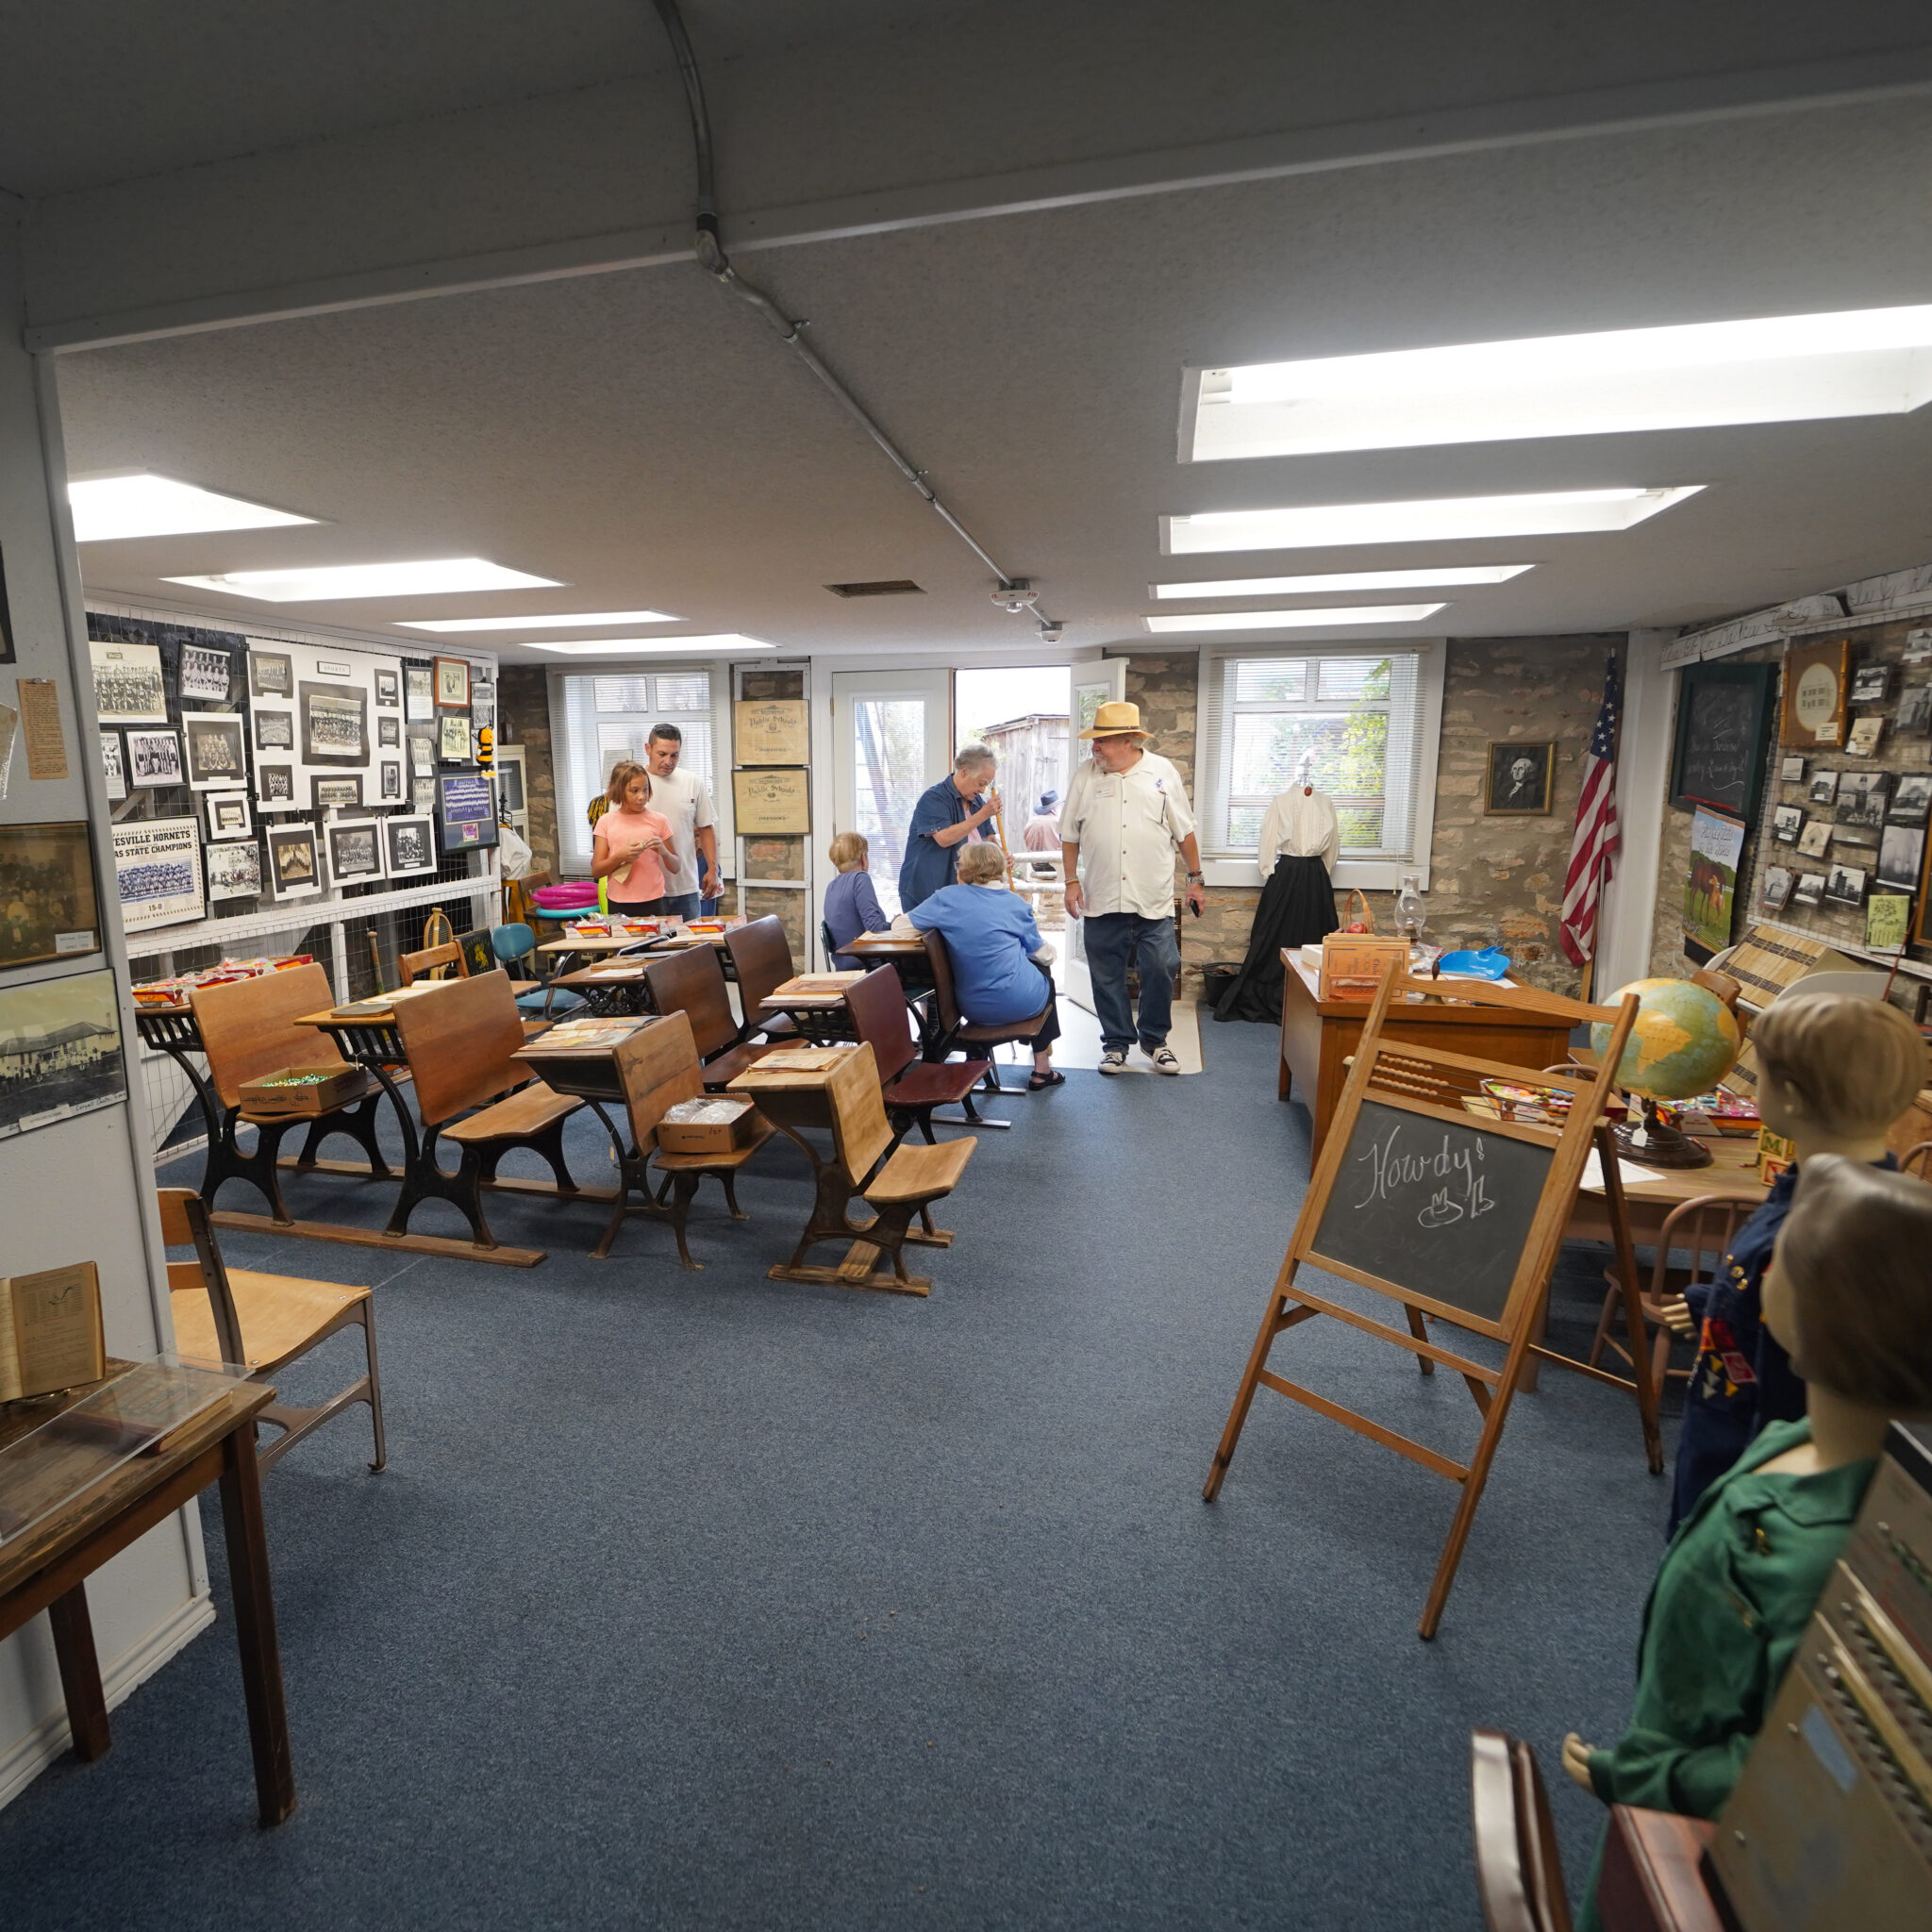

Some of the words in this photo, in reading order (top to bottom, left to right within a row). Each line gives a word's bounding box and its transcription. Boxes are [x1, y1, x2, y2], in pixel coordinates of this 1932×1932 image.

[113, 834, 151, 847] ESVILLE
[153, 830, 191, 842] HORNETS
[125, 846, 150, 858] STATE
[151, 841, 192, 854] CHAMPIONS
[148, 903, 162, 912] 15-0
[1355, 1124, 1487, 1209] Howdy!
